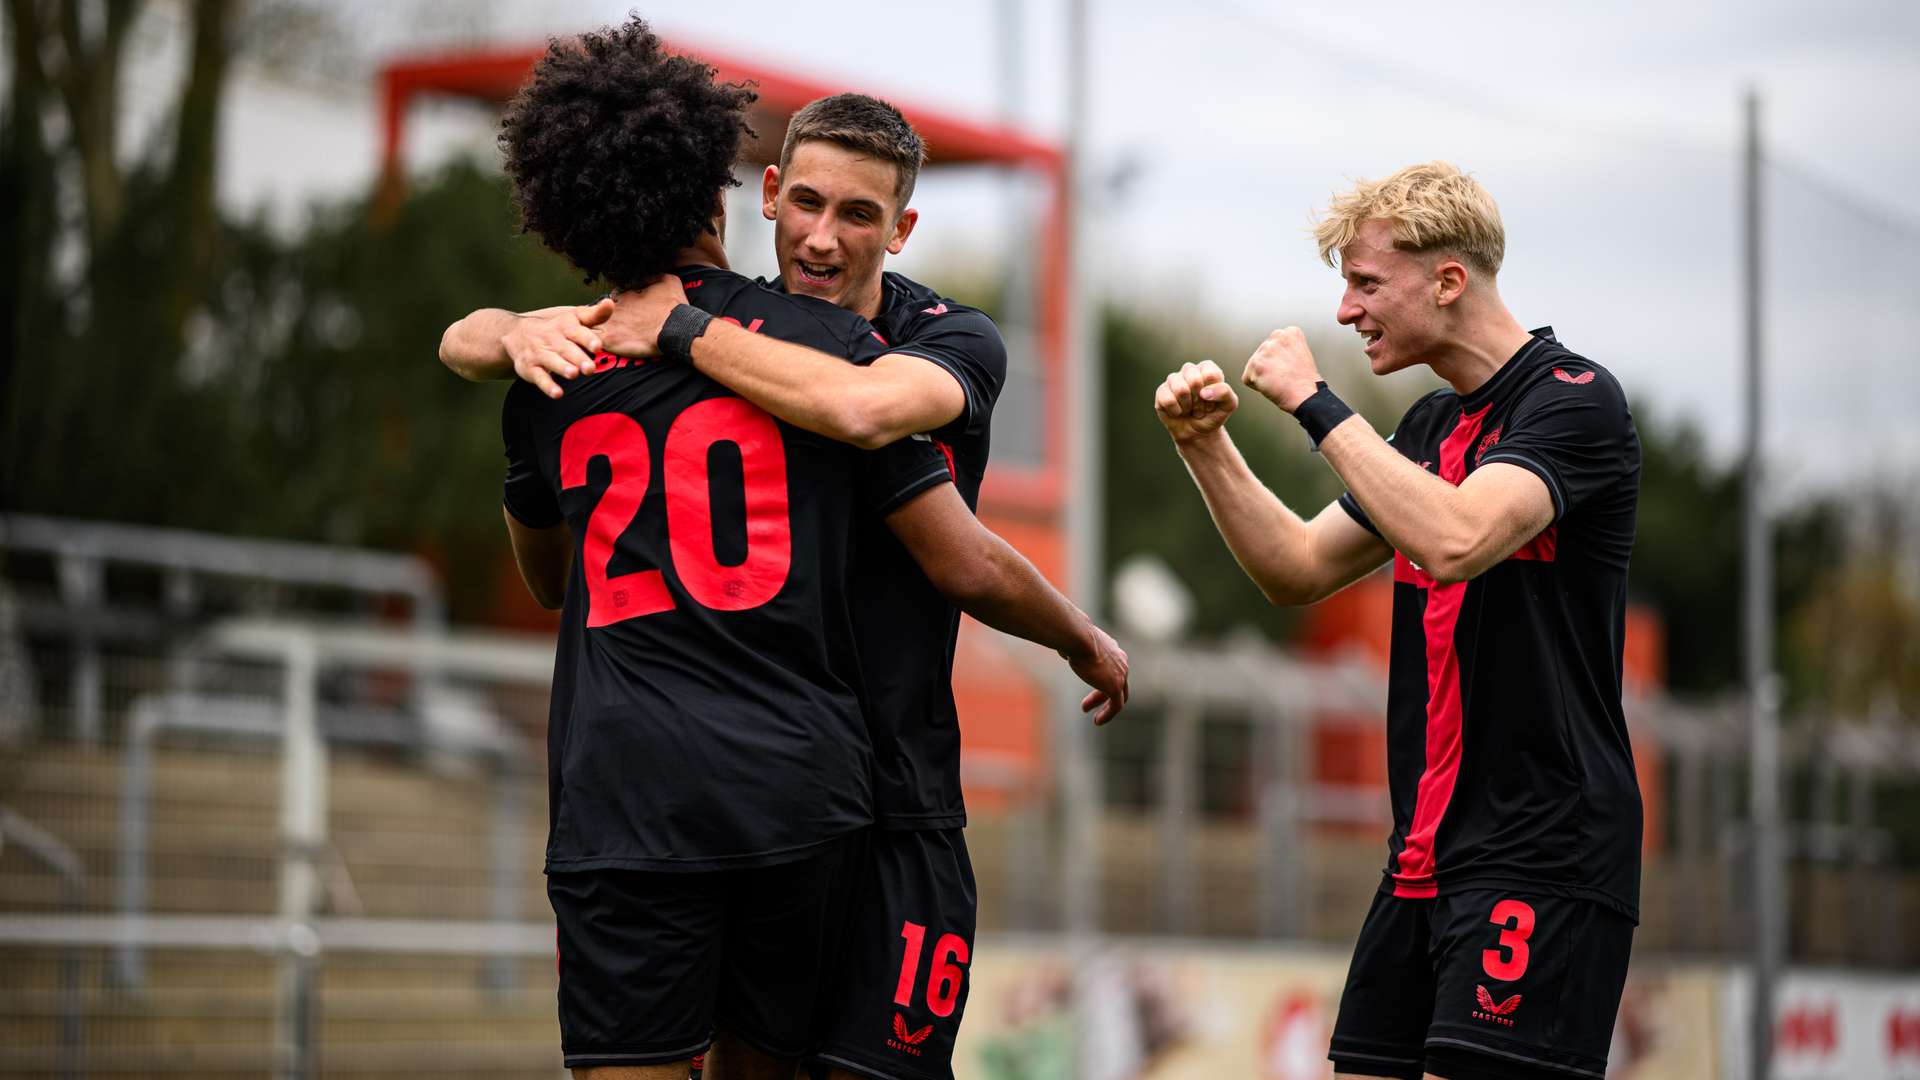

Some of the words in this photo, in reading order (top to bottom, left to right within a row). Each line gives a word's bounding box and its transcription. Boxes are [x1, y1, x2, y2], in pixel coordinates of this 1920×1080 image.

[560, 397, 791, 628] 20
[894, 920, 968, 1017] 16
[1483, 900, 1535, 981] 3
